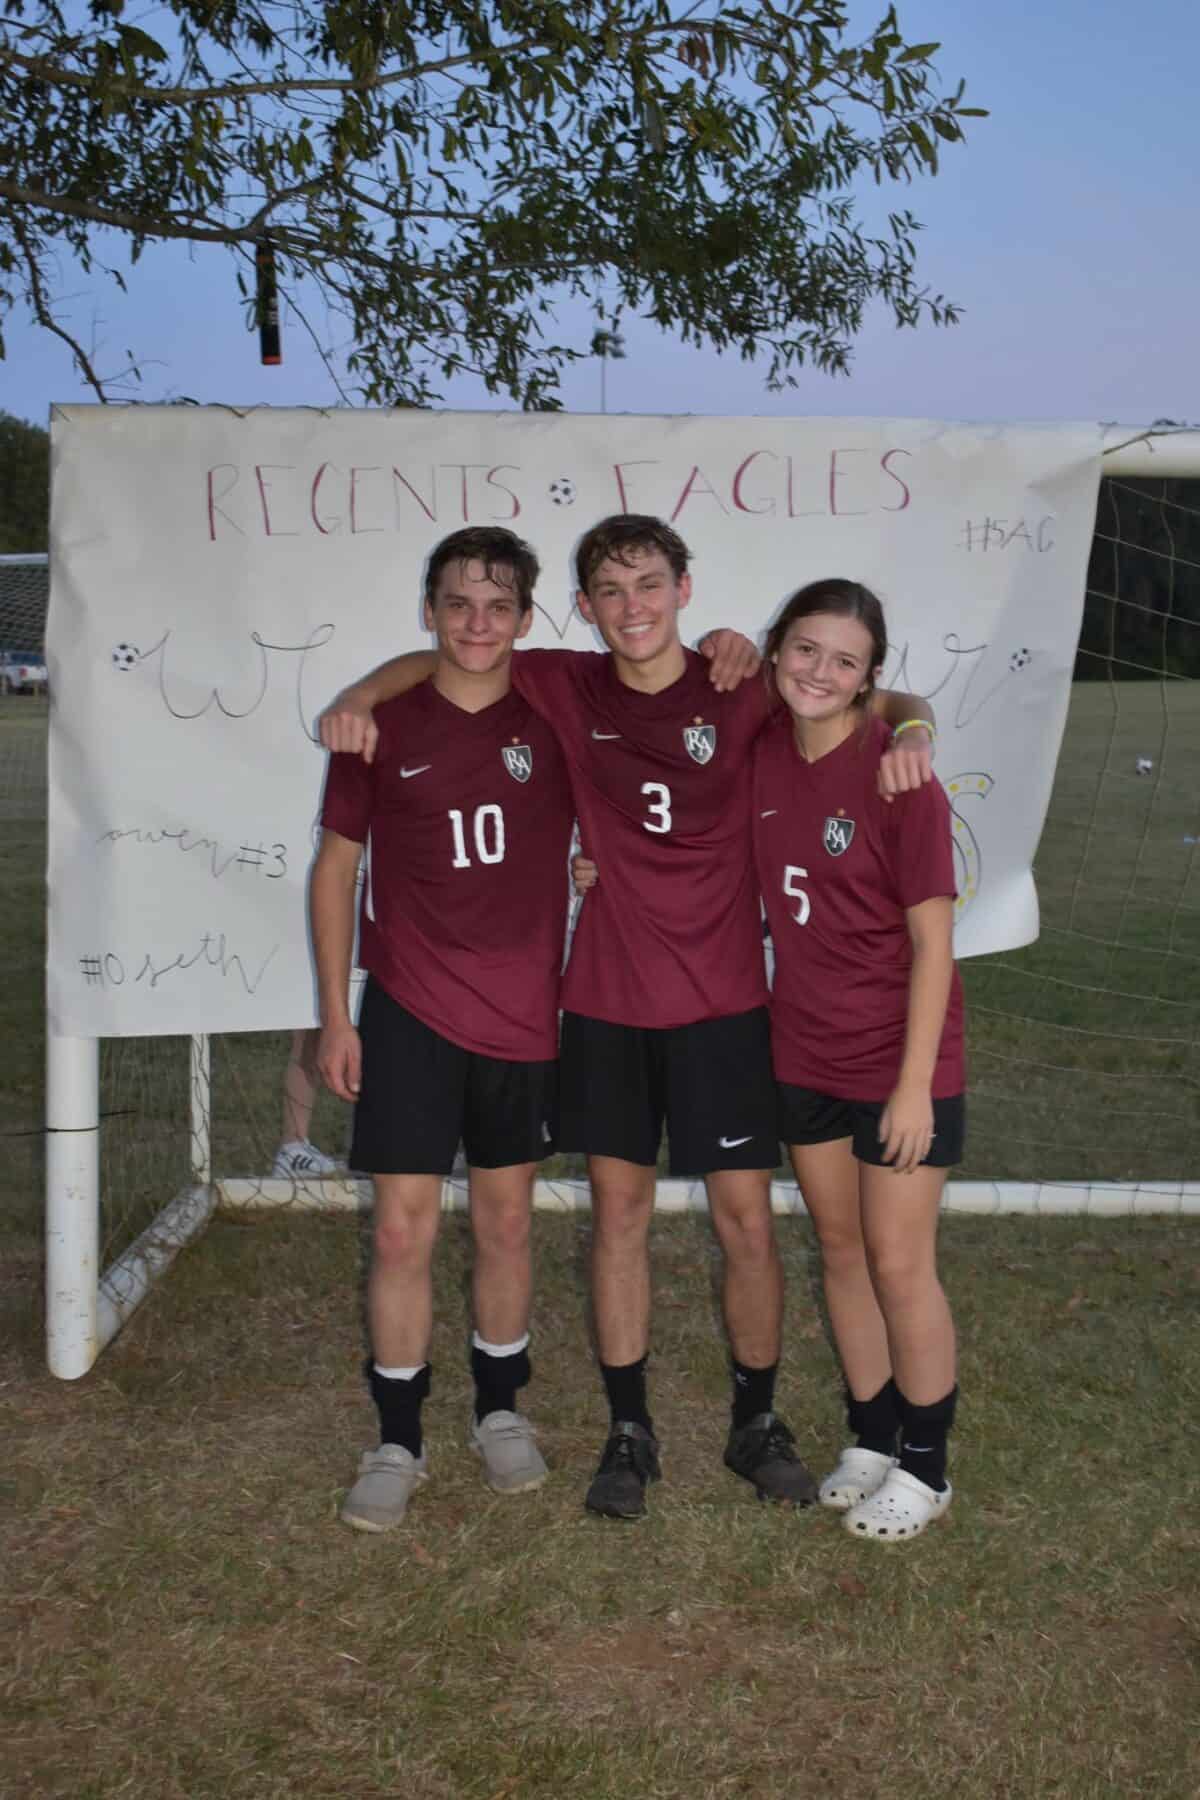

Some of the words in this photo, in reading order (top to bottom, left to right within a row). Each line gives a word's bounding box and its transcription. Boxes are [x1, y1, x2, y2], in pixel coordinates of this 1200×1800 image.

[207, 461, 521, 540] REGENTS
[447, 803, 506, 869] 10
[640, 781, 673, 834] 3
[825, 820, 848, 850] RA
[782, 864, 811, 926] 5
